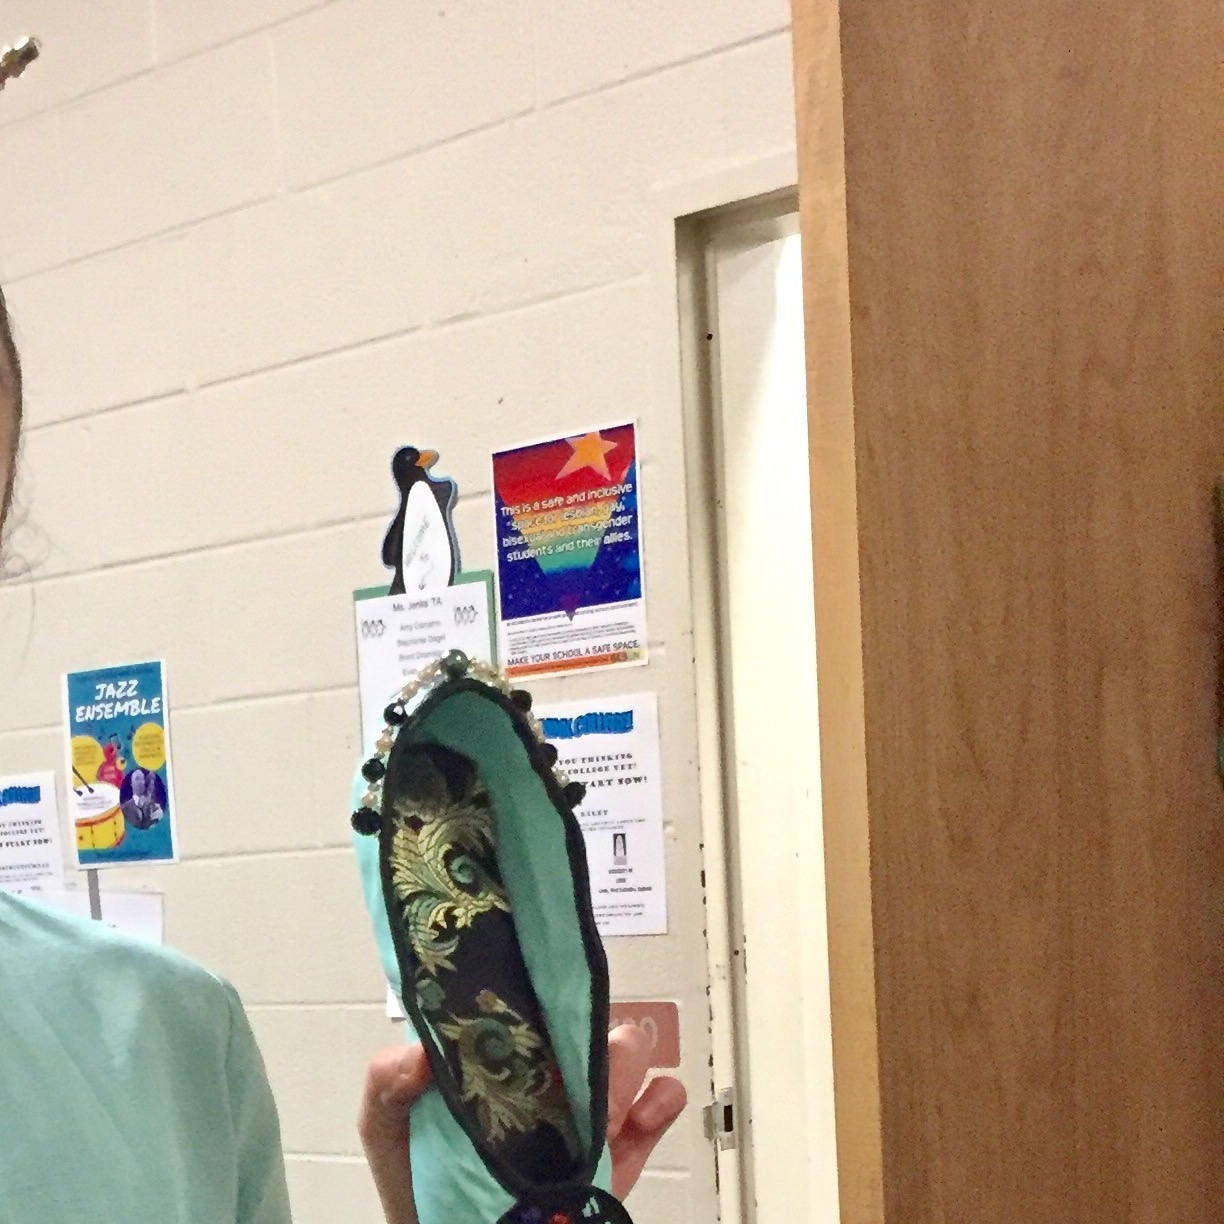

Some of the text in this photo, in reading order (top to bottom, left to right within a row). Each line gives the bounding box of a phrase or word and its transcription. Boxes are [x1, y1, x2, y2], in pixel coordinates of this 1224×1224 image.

[501, 483, 633, 516] This is a safe and inclusive
[507, 545, 554, 562] students
[555, 542, 575, 553] and
[577, 537, 600, 549] their
[507, 655, 529, 666] MAKE
[531, 652, 551, 661] YOUR
[552, 648, 583, 660] SCHOOL
[584, 646, 591, 655] A
[592, 643, 611, 653] SAFE
[95, 679, 139, 701] JAZZ
[75, 697, 161, 722] ENSEMBLE
[581, 753, 633, 764] THINKING
[567, 765, 610, 776] COLLEGE
